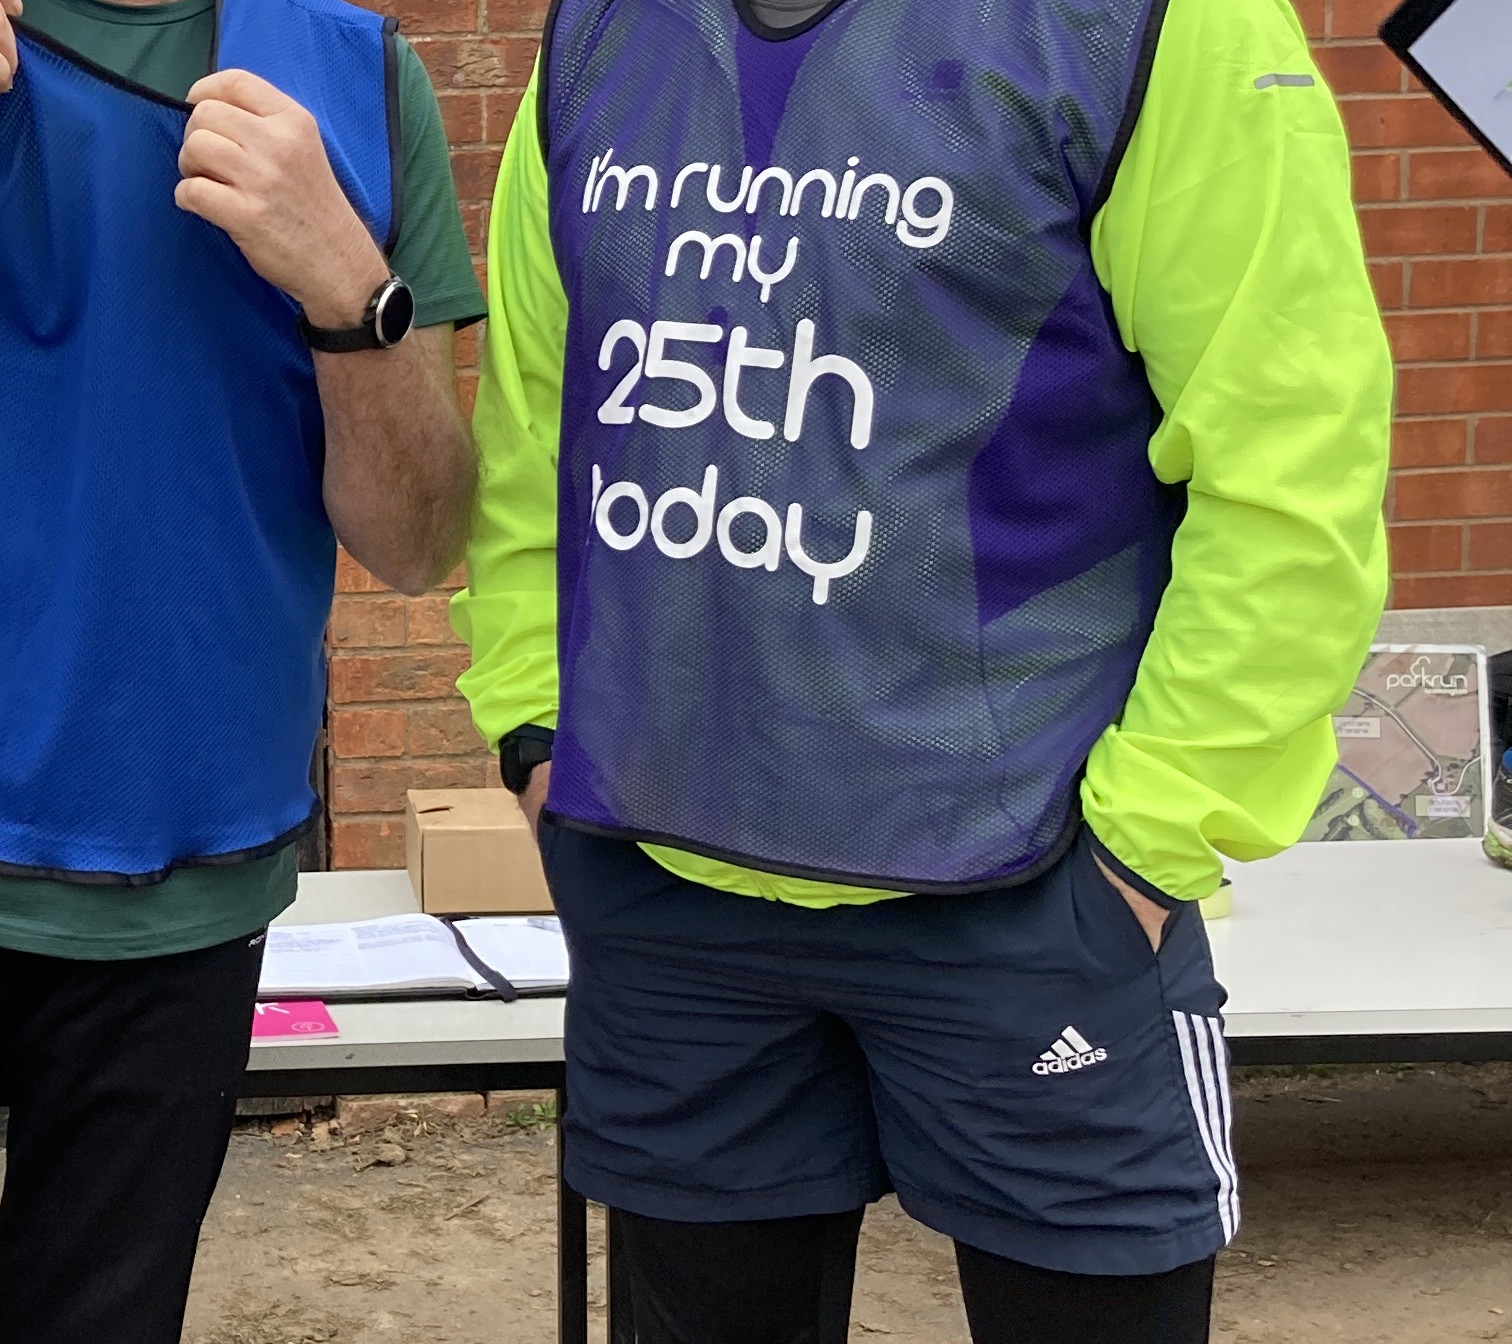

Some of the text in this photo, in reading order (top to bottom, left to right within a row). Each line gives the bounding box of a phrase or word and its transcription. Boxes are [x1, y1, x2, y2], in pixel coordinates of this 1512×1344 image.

[670, 156, 955, 248] running
[665, 230, 800, 303] my
[597, 318, 874, 450] 25th
[1386, 666, 1468, 692] parkrun
[1032, 1047, 1108, 1076] adidas
